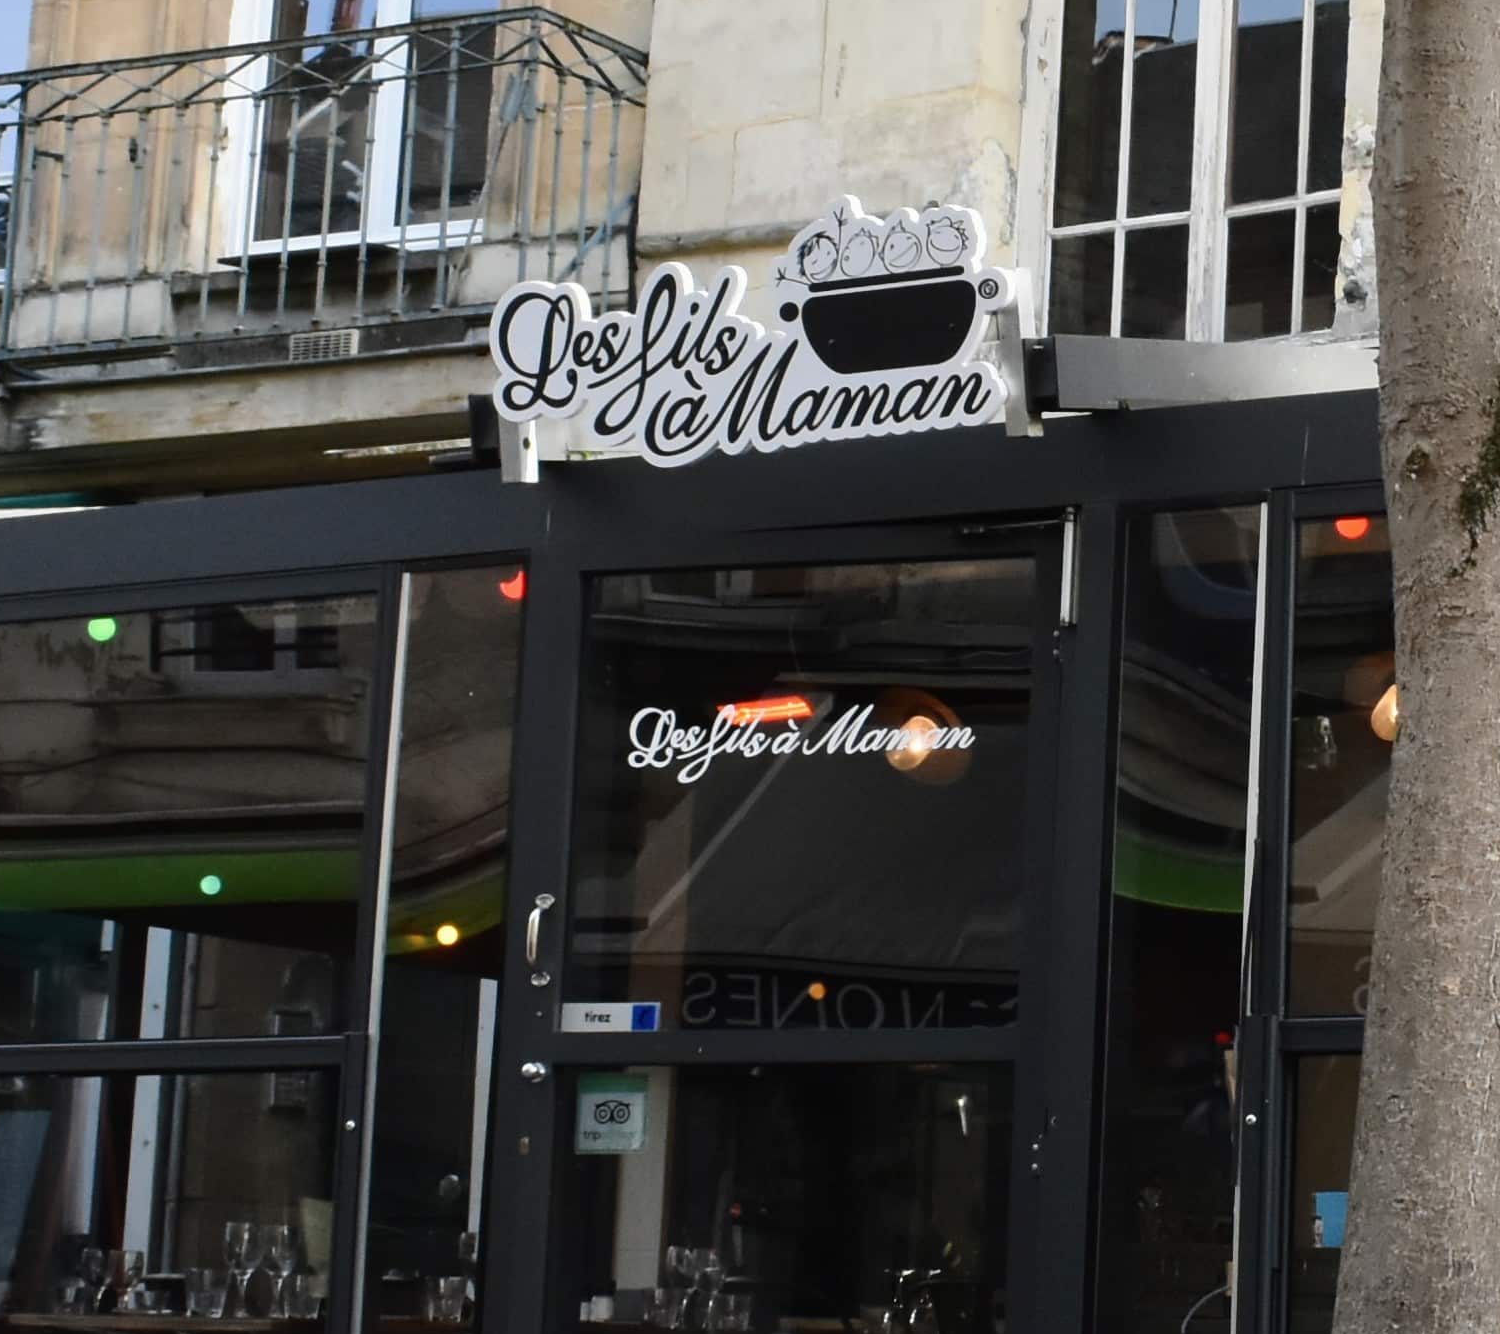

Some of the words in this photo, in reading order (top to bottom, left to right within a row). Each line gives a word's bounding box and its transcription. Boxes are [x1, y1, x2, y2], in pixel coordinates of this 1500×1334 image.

[498, 291, 632, 412] Les
[586, 273, 749, 437] fils
[644, 338, 993, 457] Maman
[661, 369, 710, 441] à
[627, 706, 706, 768] Les
[676, 703, 773, 784] fils
[771, 718, 802, 755] à
[802, 703, 976, 756] Maman
[584, 1012, 611, 1023] tirez
